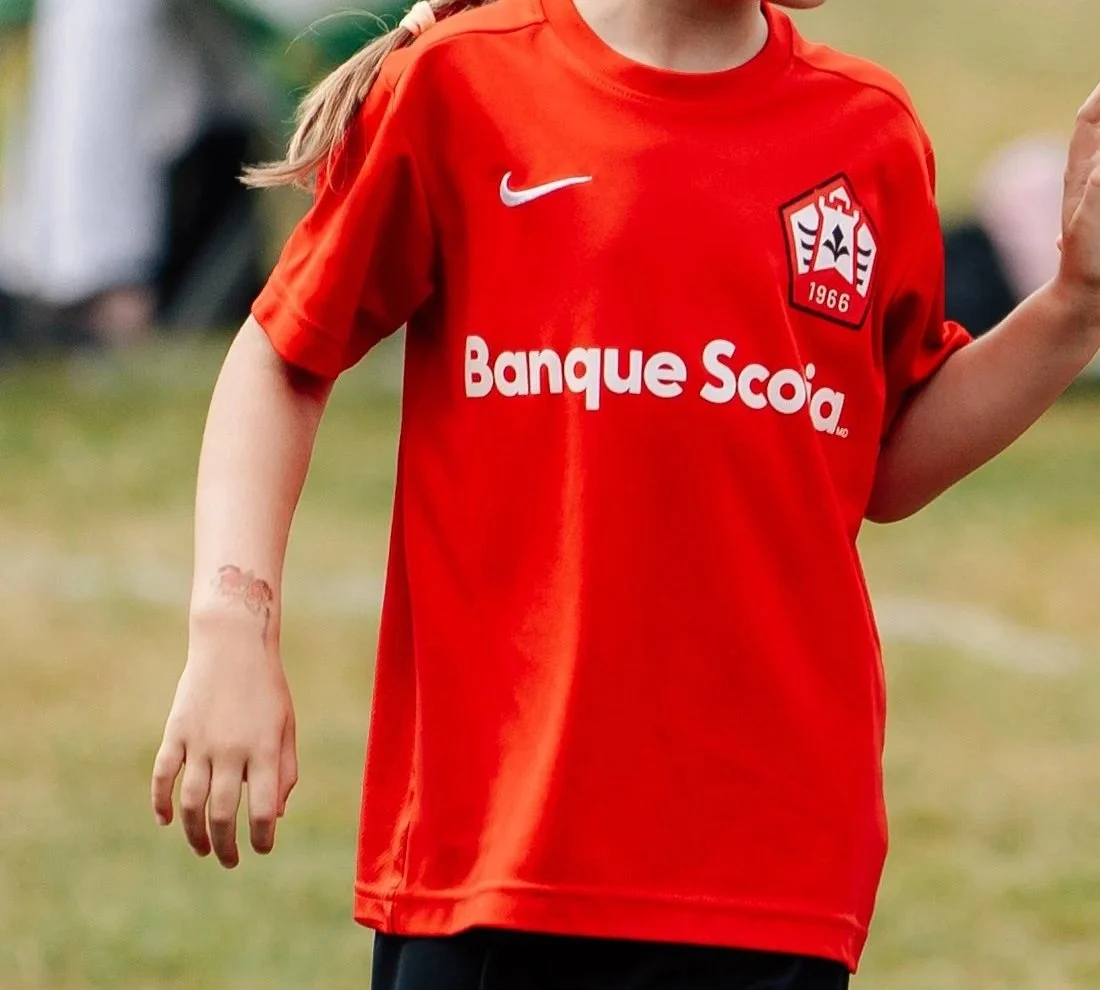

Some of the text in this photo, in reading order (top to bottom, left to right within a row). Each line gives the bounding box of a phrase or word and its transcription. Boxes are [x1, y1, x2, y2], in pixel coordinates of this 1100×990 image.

[808, 281, 850, 312] 1966
[464, 335, 687, 411] Banque
[699, 339, 846, 435] Scoia
